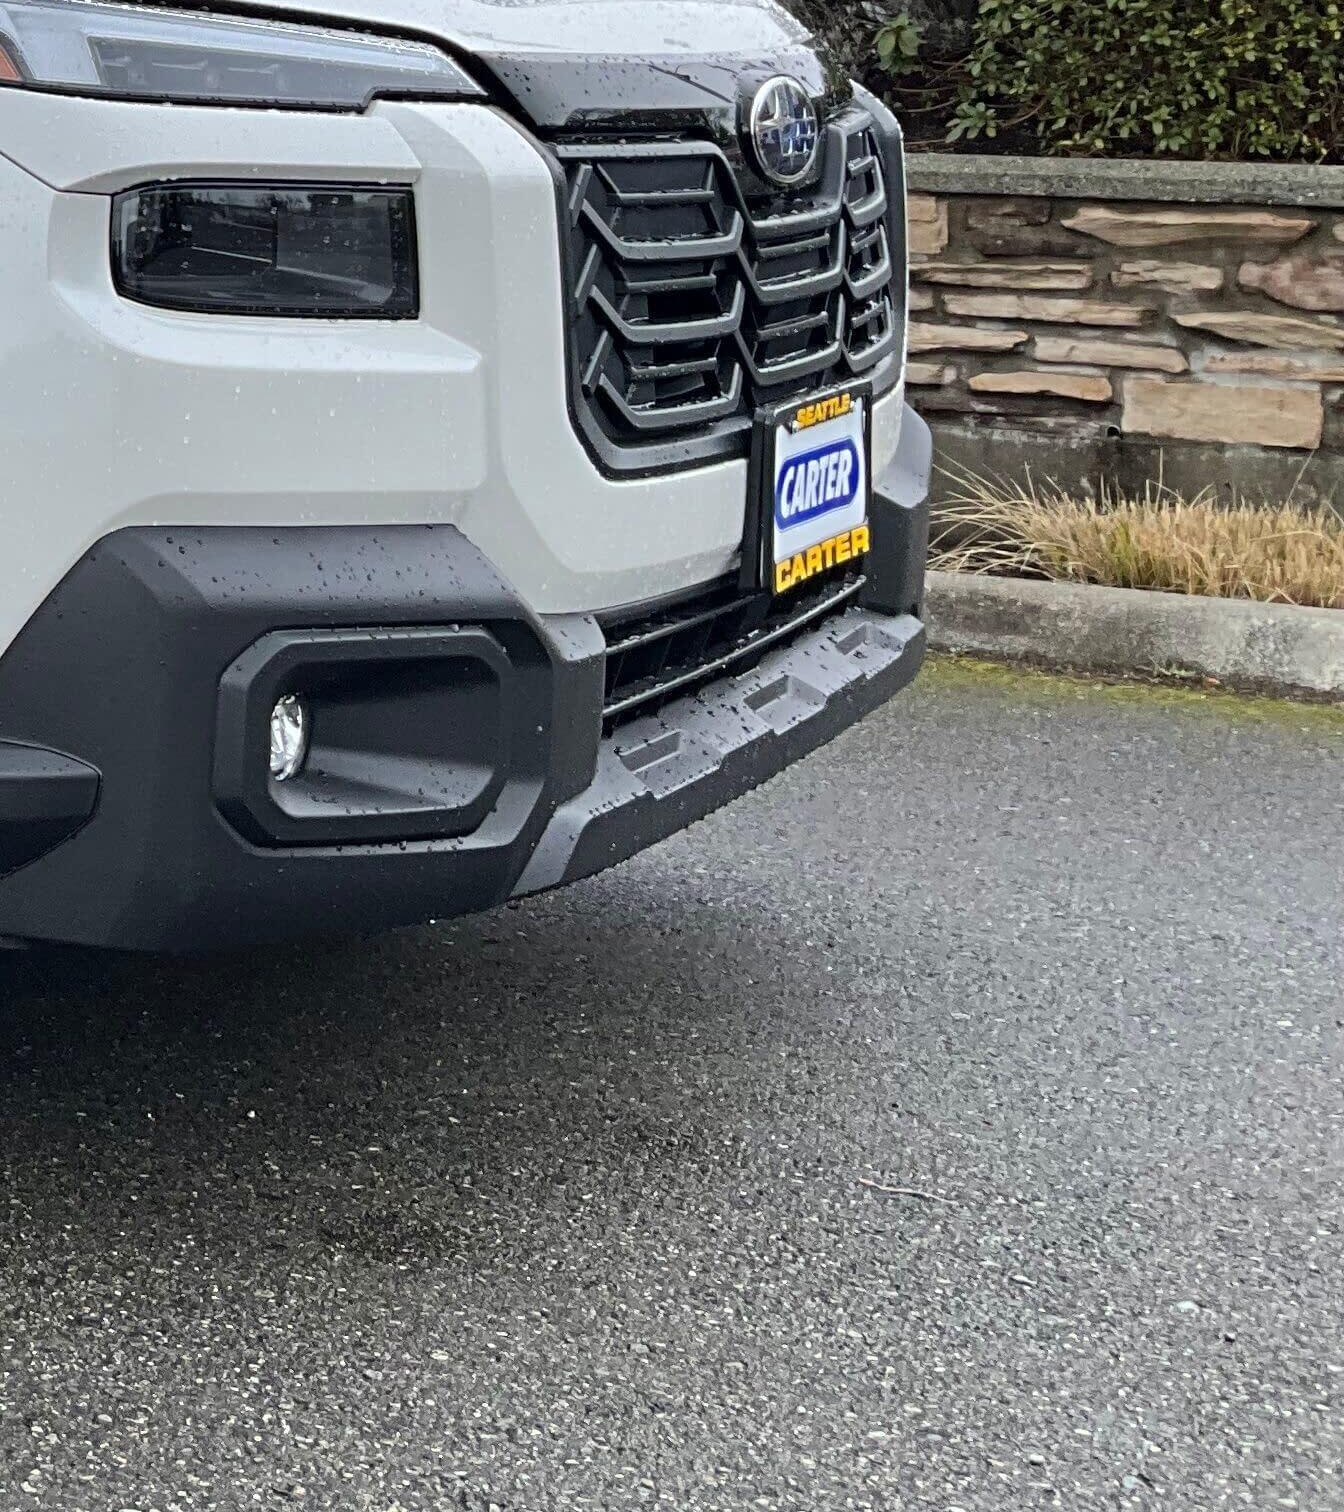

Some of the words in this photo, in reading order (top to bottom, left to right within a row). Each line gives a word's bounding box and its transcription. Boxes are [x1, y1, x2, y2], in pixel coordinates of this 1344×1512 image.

[795, 393, 852, 429] SEATTLE
[779, 449, 853, 519] CARTER
[775, 525, 870, 593] CARTER
